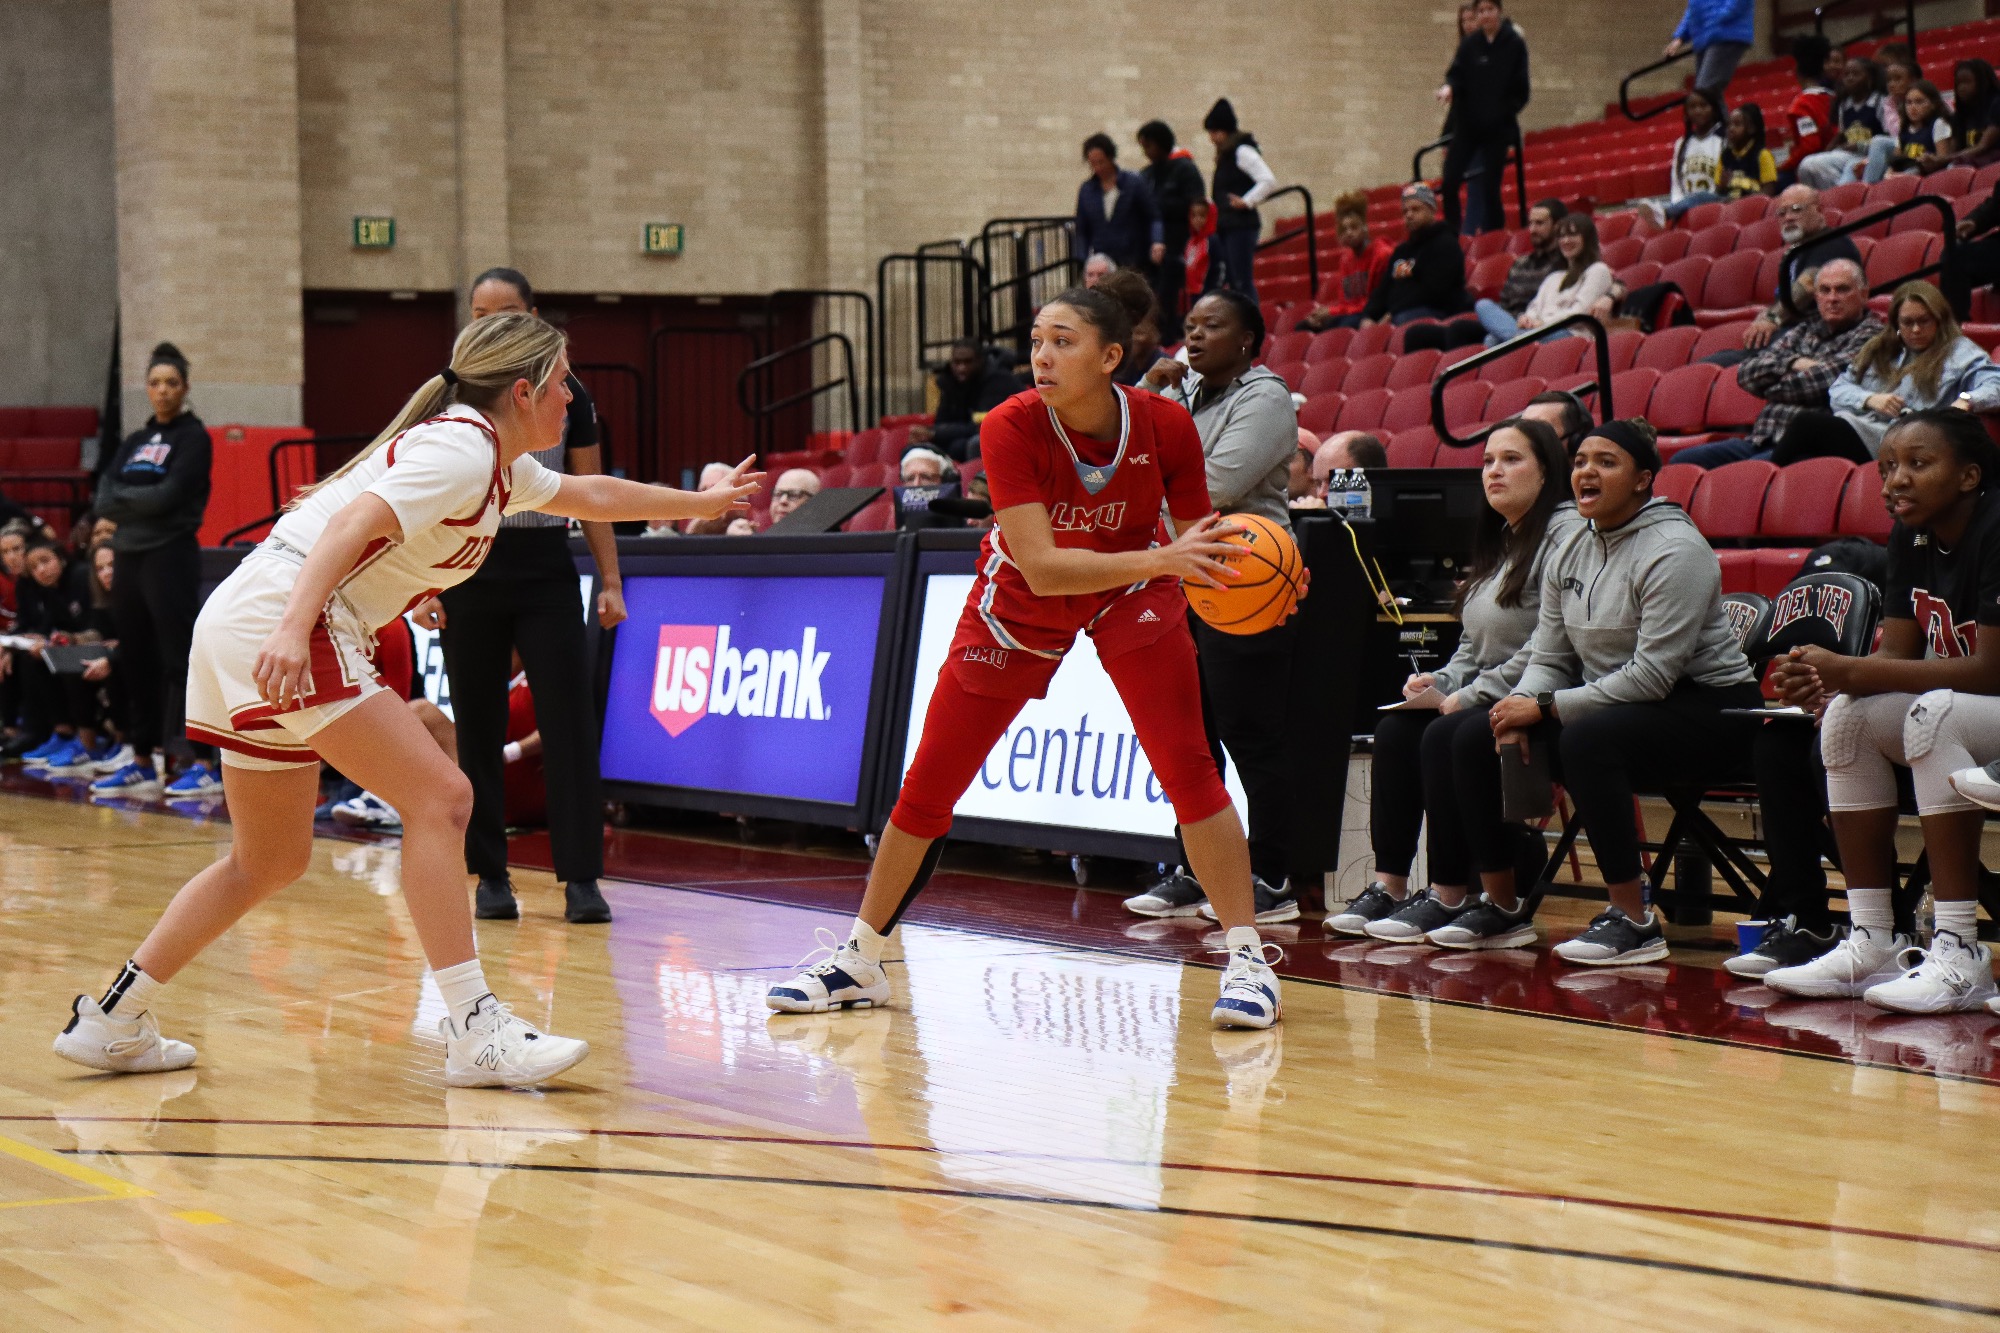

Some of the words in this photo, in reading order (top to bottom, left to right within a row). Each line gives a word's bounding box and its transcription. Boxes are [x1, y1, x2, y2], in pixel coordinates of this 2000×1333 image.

[359, 219, 389, 245] EXIT
[650, 226, 678, 250] EXIT
[1050, 502, 1126, 532] LMU
[430, 535, 496, 570] DE
[1722, 601, 1759, 652] VER
[1767, 583, 1853, 642] DENVER
[963, 645, 1008, 669] LMU
